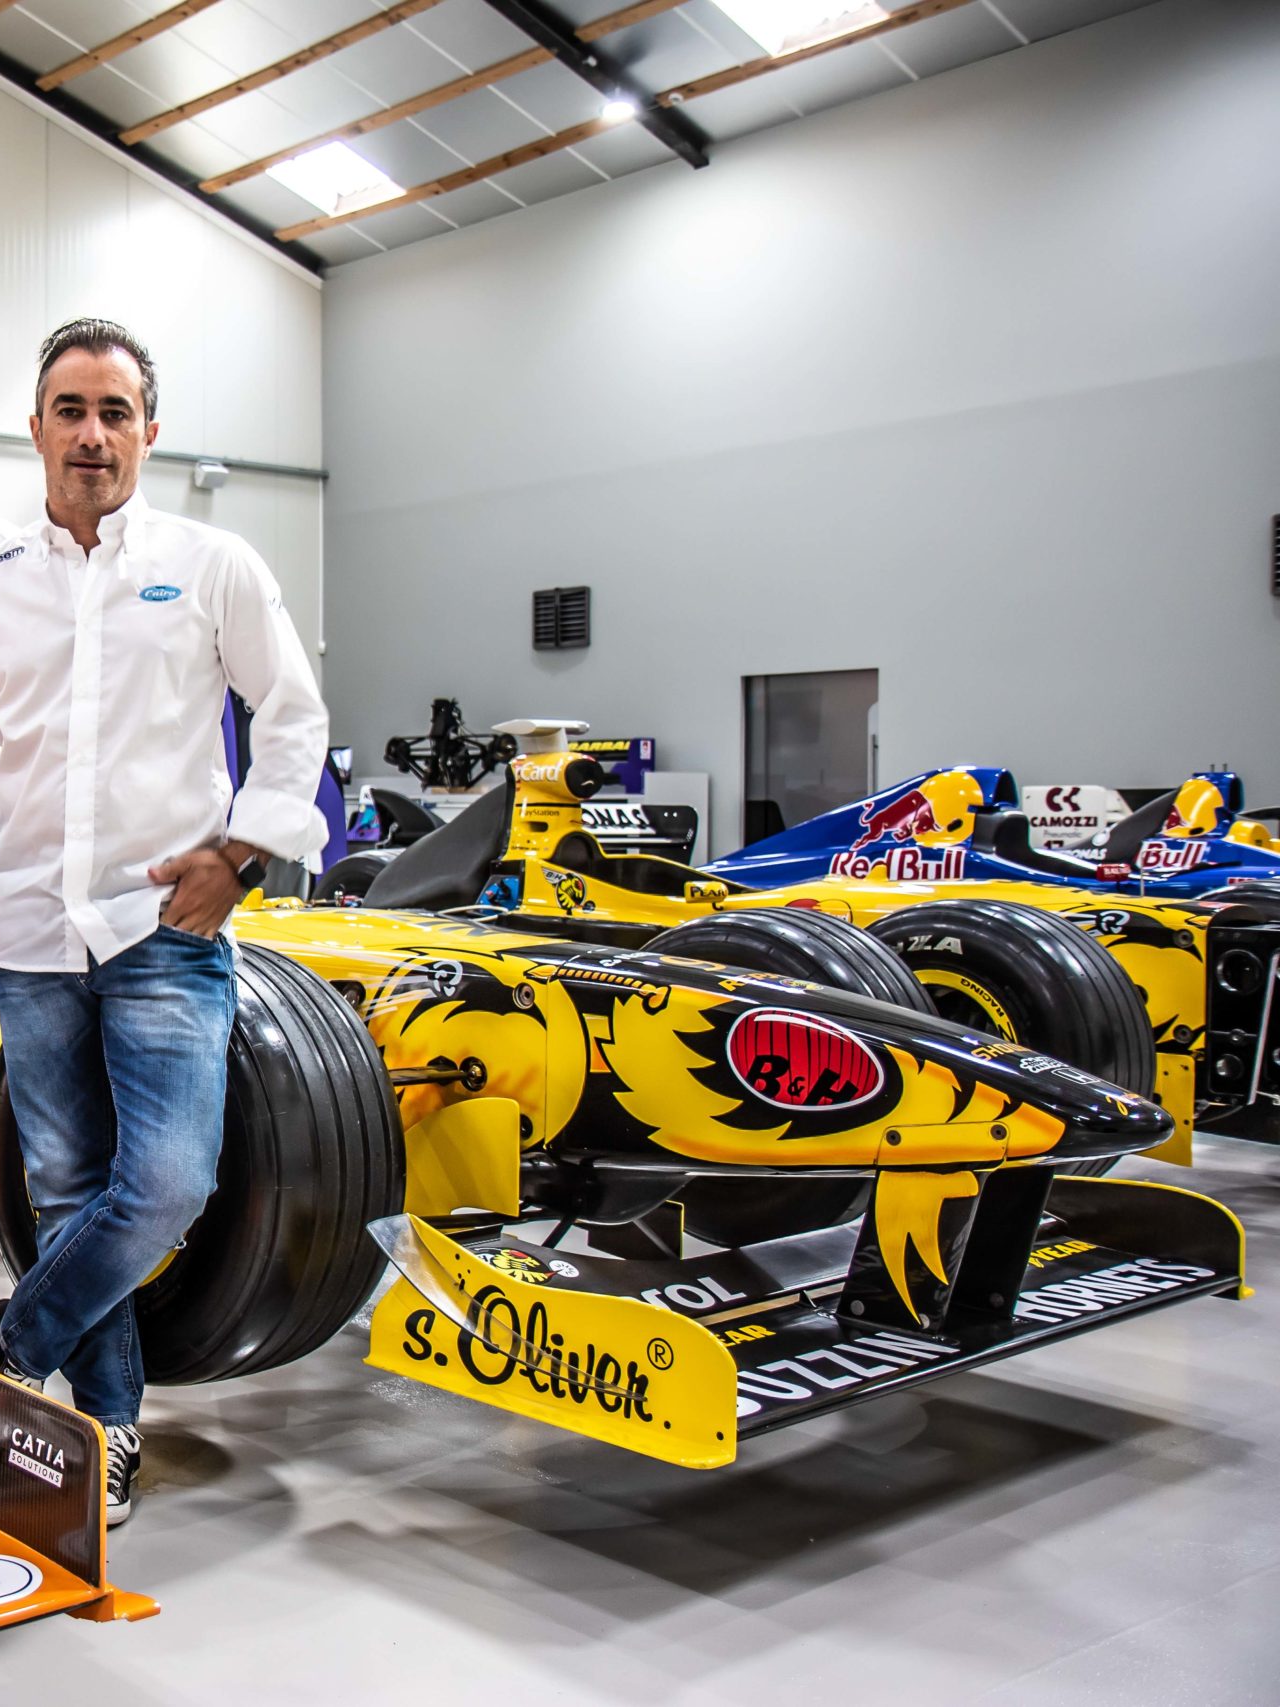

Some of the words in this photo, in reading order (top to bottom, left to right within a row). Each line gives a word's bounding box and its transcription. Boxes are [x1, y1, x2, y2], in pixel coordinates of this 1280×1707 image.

[145, 588, 177, 598] Caira
[1030, 816, 1098, 828] CAMOZZI
[11, 1427, 65, 1470] CATIA
[11, 1451, 61, 1484] SOLUTIONS
